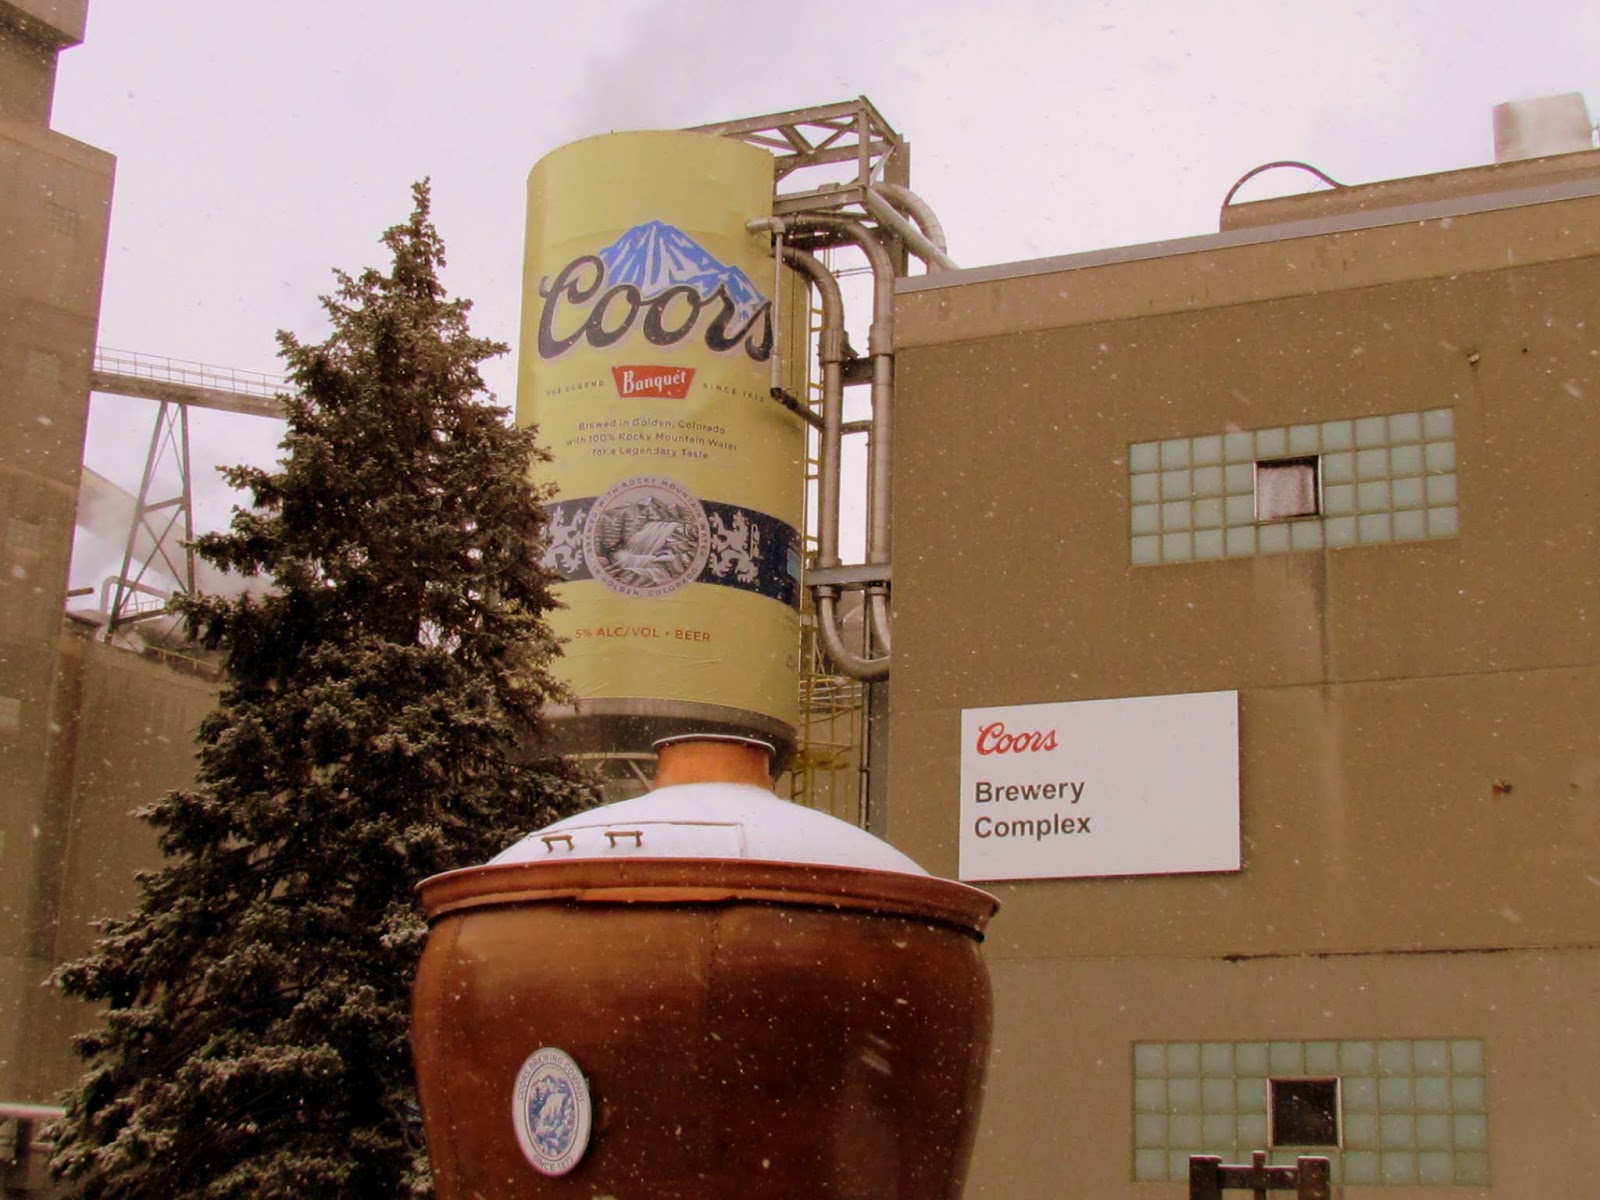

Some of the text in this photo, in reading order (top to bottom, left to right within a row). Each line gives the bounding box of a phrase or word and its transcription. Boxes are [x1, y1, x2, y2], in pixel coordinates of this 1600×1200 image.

[538, 255, 773, 362] Coors
[622, 370, 687, 395] Banquet
[703, 382, 737, 395] SINCE
[579, 418, 726, 434] Brewed in Golden, Colorado
[566, 432, 737, 451] with 100% Rocky Mountain Water
[592, 448, 607, 456] for
[619, 446, 677, 457] Legendary
[681, 448, 709, 460] Taste
[621, 477, 656, 488] ROCKY
[575, 626, 711, 642] 5% ALC/VOL BEER
[976, 722, 1058, 755] Coors
[975, 781, 1085, 804] Brewery
[974, 813, 1091, 841] Complex
